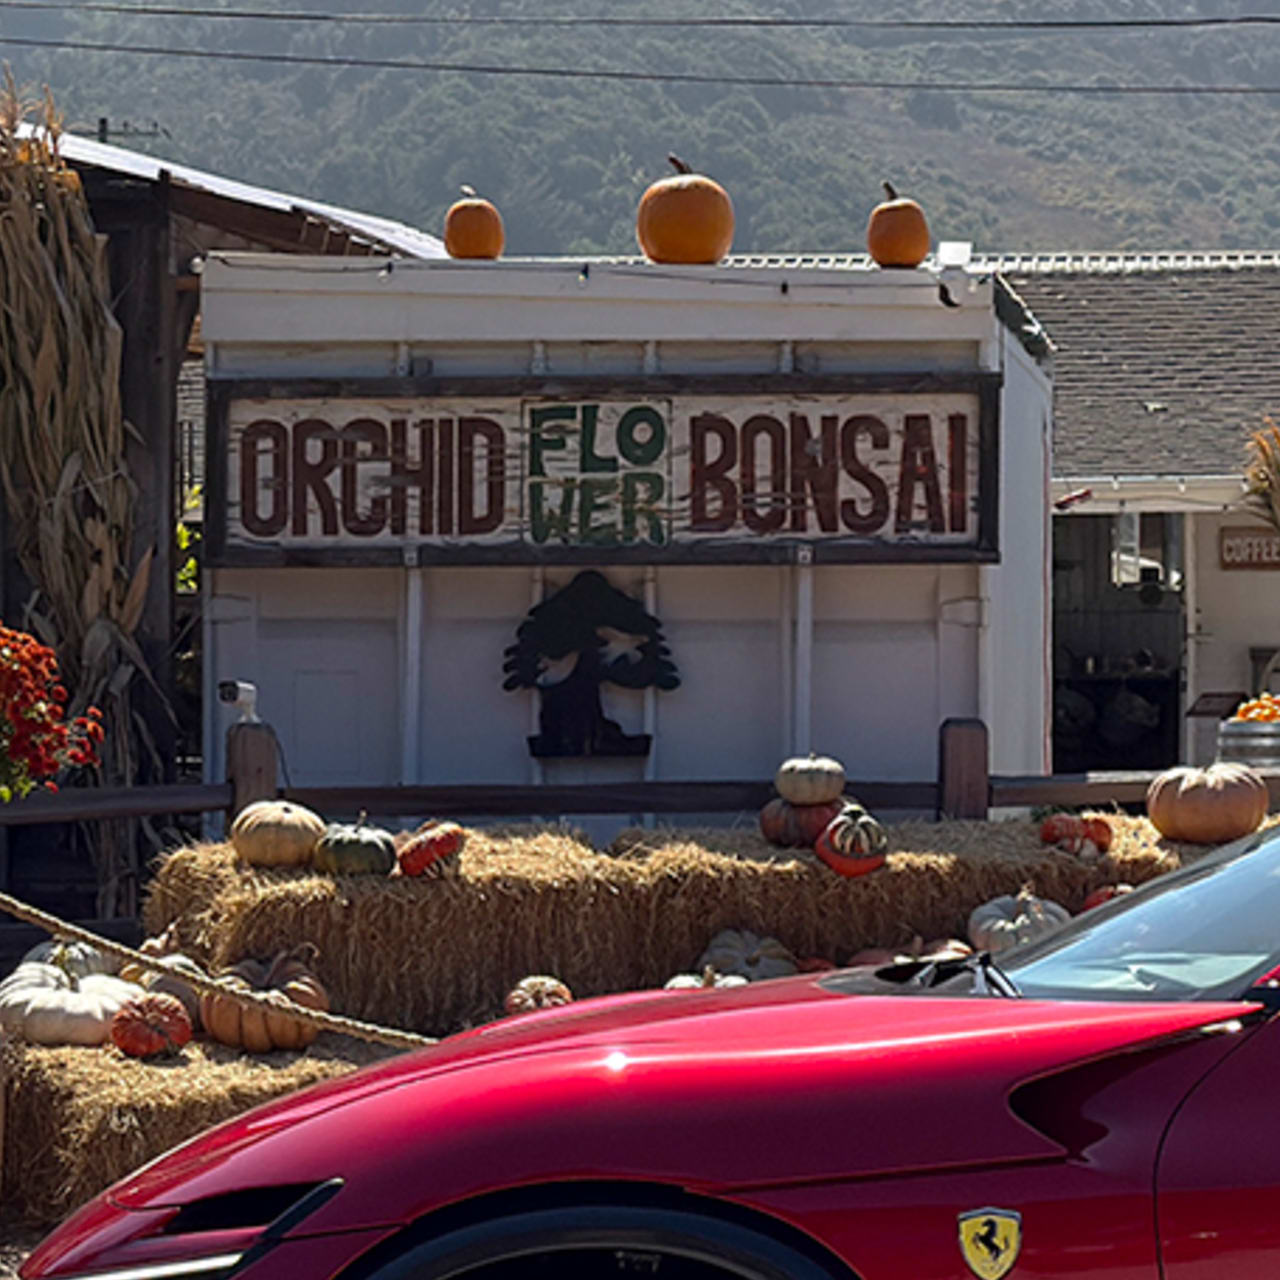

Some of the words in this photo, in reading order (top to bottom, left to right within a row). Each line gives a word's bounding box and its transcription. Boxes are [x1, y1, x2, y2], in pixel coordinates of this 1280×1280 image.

[240, 415, 506, 538] ORCHID
[529, 404, 667, 476] FLO
[688, 411, 968, 535] BONSAI
